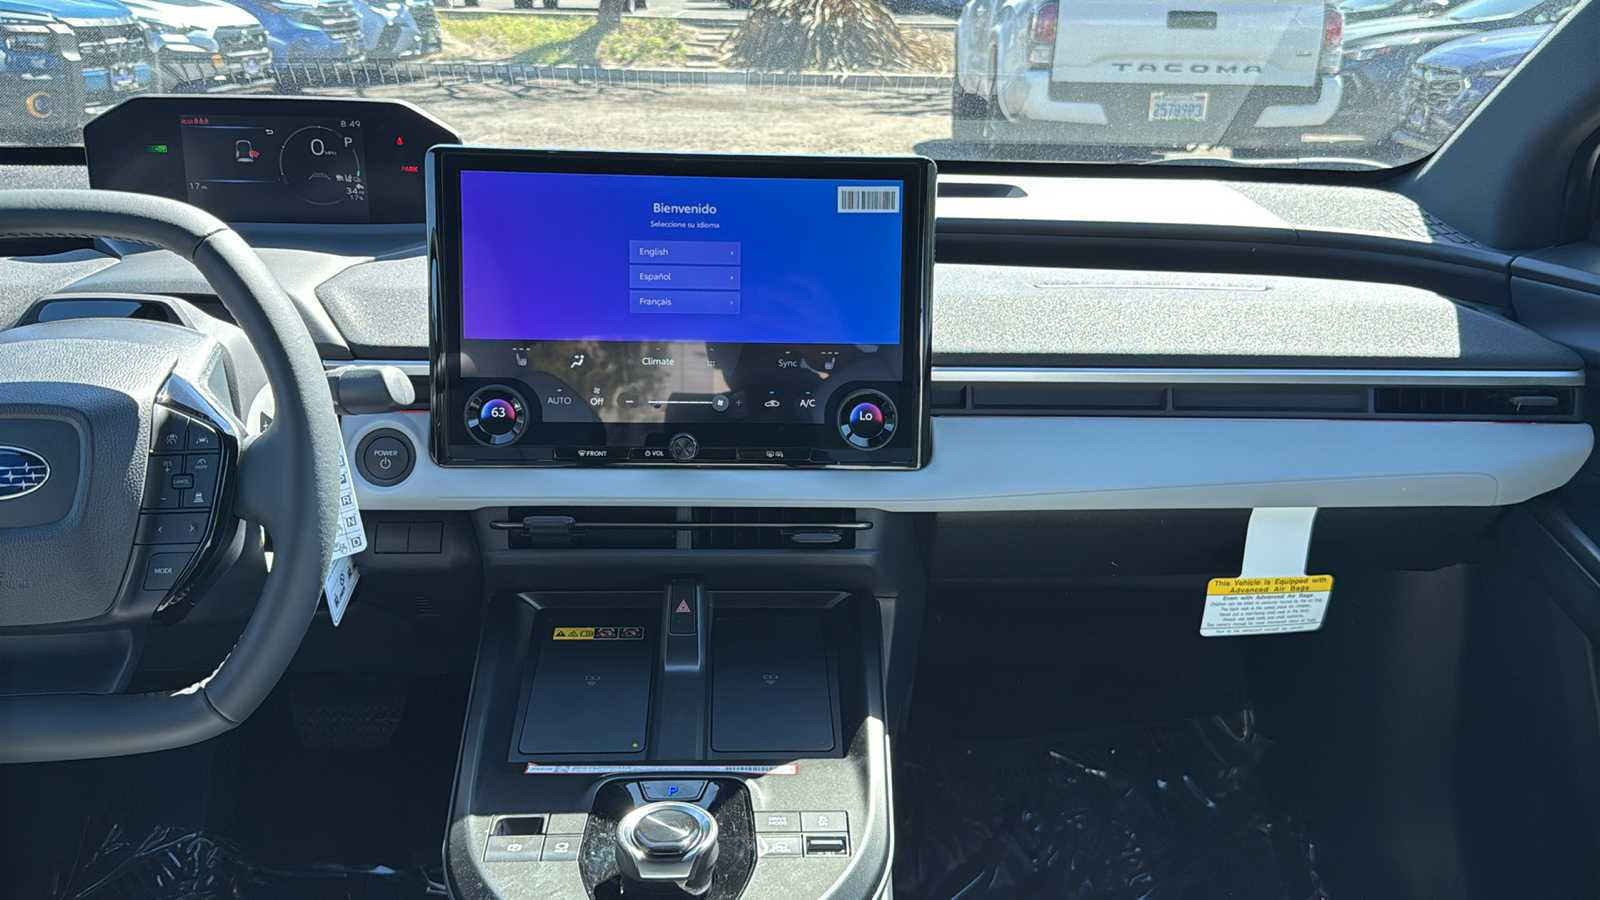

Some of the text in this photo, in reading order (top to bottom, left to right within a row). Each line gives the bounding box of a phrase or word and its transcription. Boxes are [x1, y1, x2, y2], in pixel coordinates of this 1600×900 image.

[1112, 63, 1263, 74] TACOMA
[340, 120, 361, 128] 8:49
[310, 138, 325, 156] 0
[344, 137, 353, 148] P
[189, 182, 200, 190] 17
[653, 202, 718, 214] Bienvenido
[650, 220, 686, 228] Seleccione
[696, 221, 720, 229] idioma
[639, 247, 669, 258] English
[639, 272, 672, 282] Español
[639, 297, 672, 307] Français
[641, 357, 675, 367] Climate
[778, 359, 798, 369] Sync
[547, 396, 572, 406] AUTO
[589, 396, 604, 406] Off
[799, 399, 816, 409] A/C
[490, 406, 506, 418] 63
[859, 411, 873, 421] Lo
[1275, 578, 1308, 586] Equipped
[667, 785, 679, 796] P
